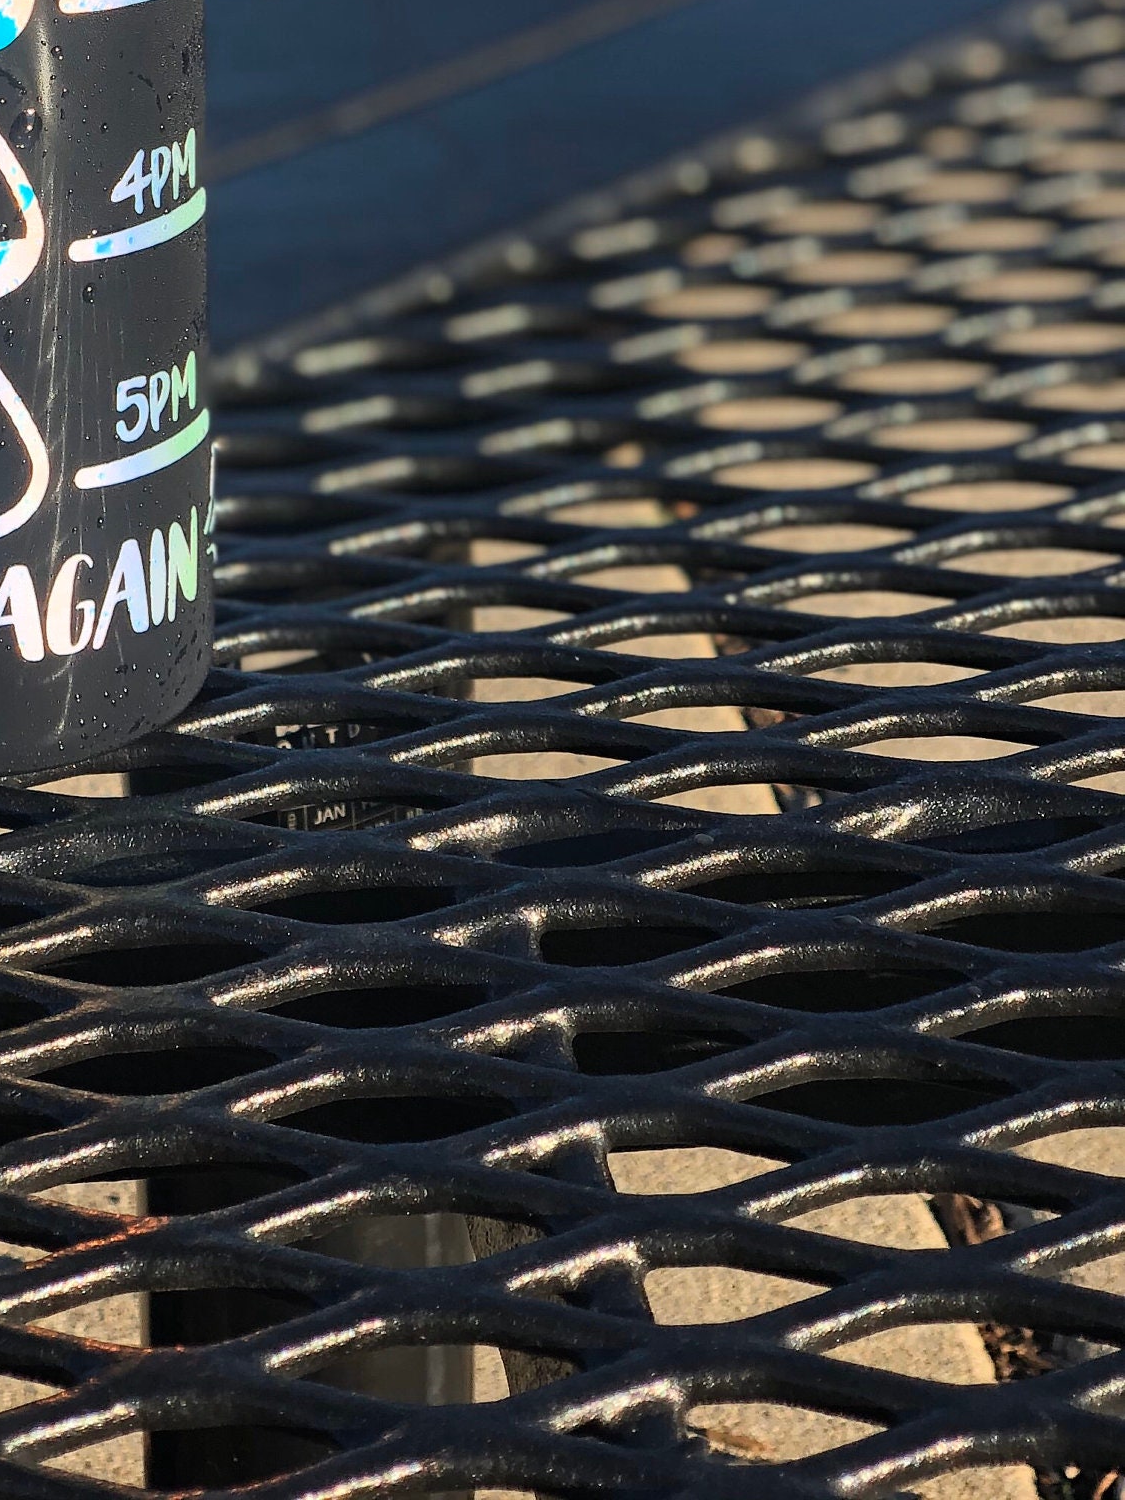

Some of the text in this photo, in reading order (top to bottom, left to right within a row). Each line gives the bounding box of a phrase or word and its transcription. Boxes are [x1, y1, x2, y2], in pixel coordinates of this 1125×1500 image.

[111, 128, 196, 214] 4PM
[116, 351, 197, 443] 5PM
[314, 803, 346, 825] JAN
